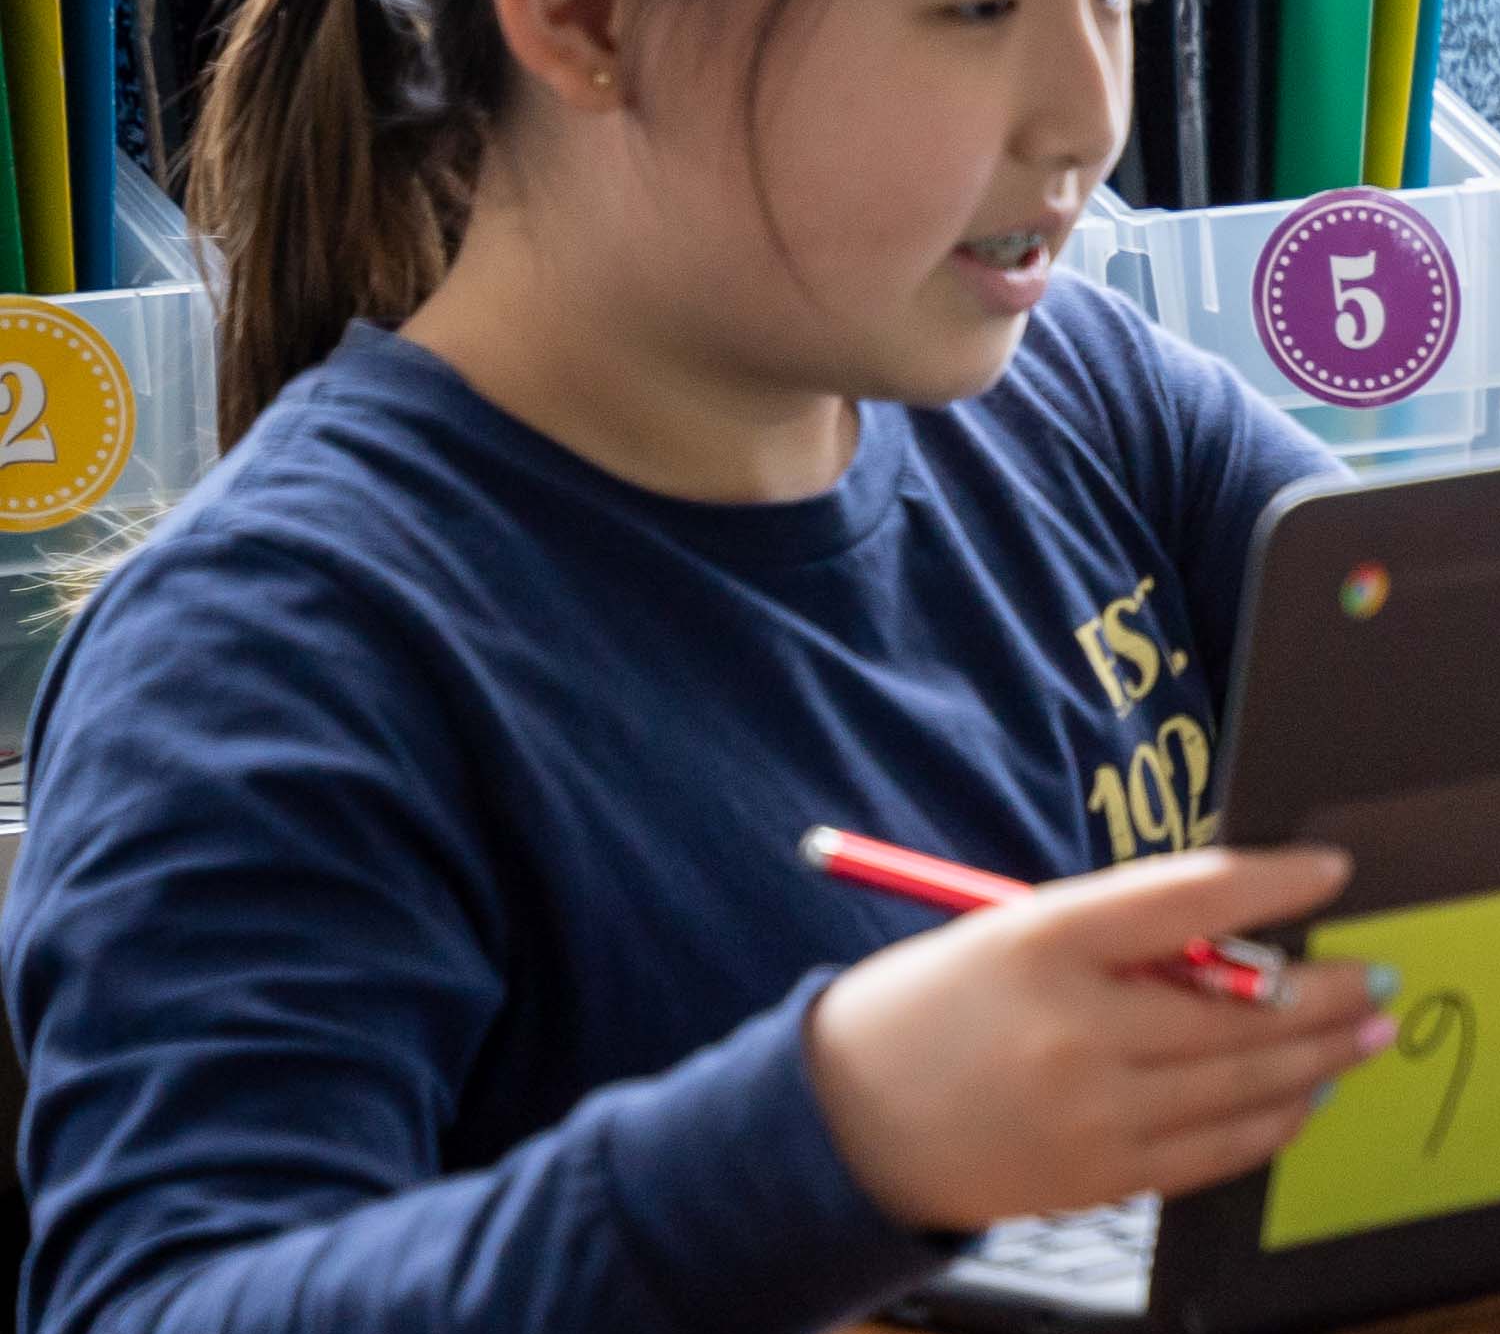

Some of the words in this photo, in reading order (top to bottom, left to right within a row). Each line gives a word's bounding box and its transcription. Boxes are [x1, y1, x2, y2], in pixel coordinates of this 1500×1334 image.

[1328, 249, 1387, 351] 5
[0, 361, 56, 465] 2
[1397, 987, 1477, 1160] 9
